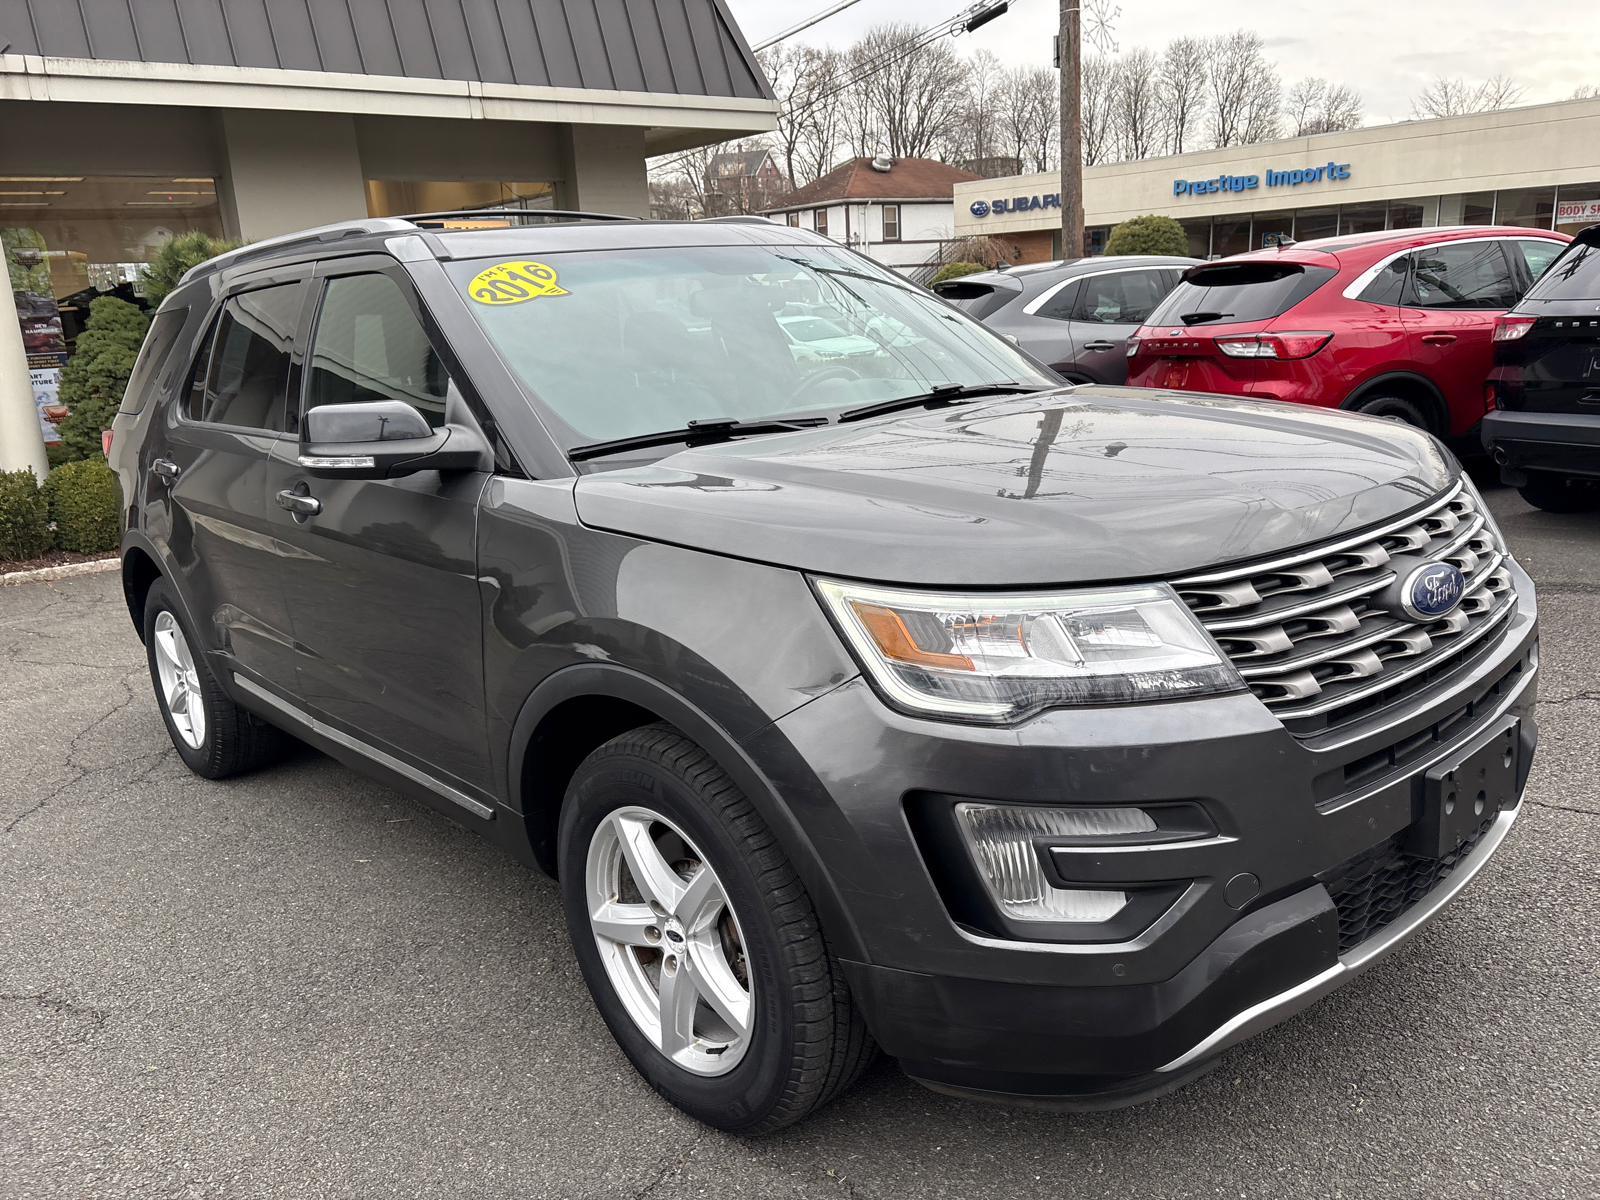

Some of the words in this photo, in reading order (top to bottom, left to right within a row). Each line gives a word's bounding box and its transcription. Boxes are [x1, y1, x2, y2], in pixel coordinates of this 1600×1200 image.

[1173, 175, 1259, 196] Prestige
[1266, 161, 1350, 187] Imports
[1559, 205, 1587, 216] BODY
[475, 264, 553, 302] 2016
[478, 270, 498, 282] I'M
[1424, 570, 1459, 608] Ford
